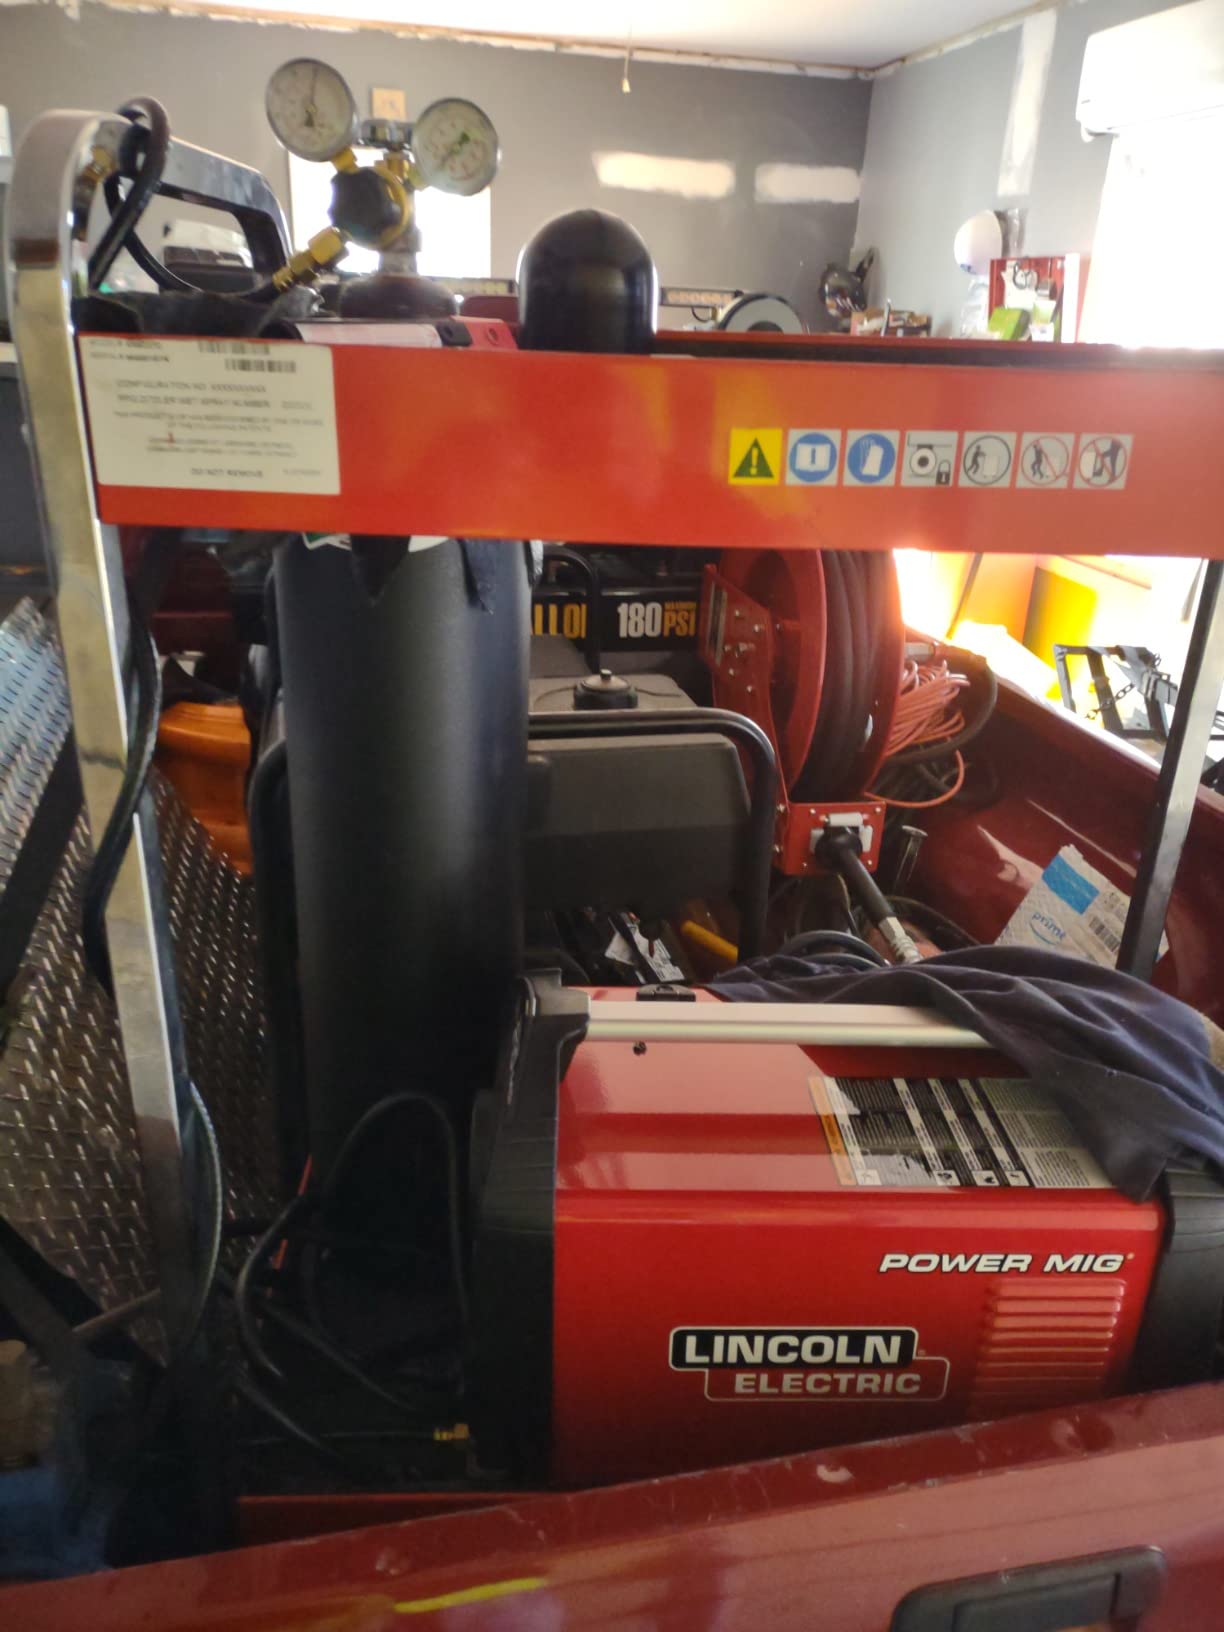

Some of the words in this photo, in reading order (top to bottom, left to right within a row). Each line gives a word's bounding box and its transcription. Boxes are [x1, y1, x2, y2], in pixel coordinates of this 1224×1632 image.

[617, 601, 662, 639] 180
[663, 610, 697, 638] PSI
[878, 1252, 1033, 1273] POWER
[1042, 1253, 1125, 1273] MIG
[684, 1334, 903, 1365] LINCOLN
[733, 1372, 921, 1395] ELECTRIC
